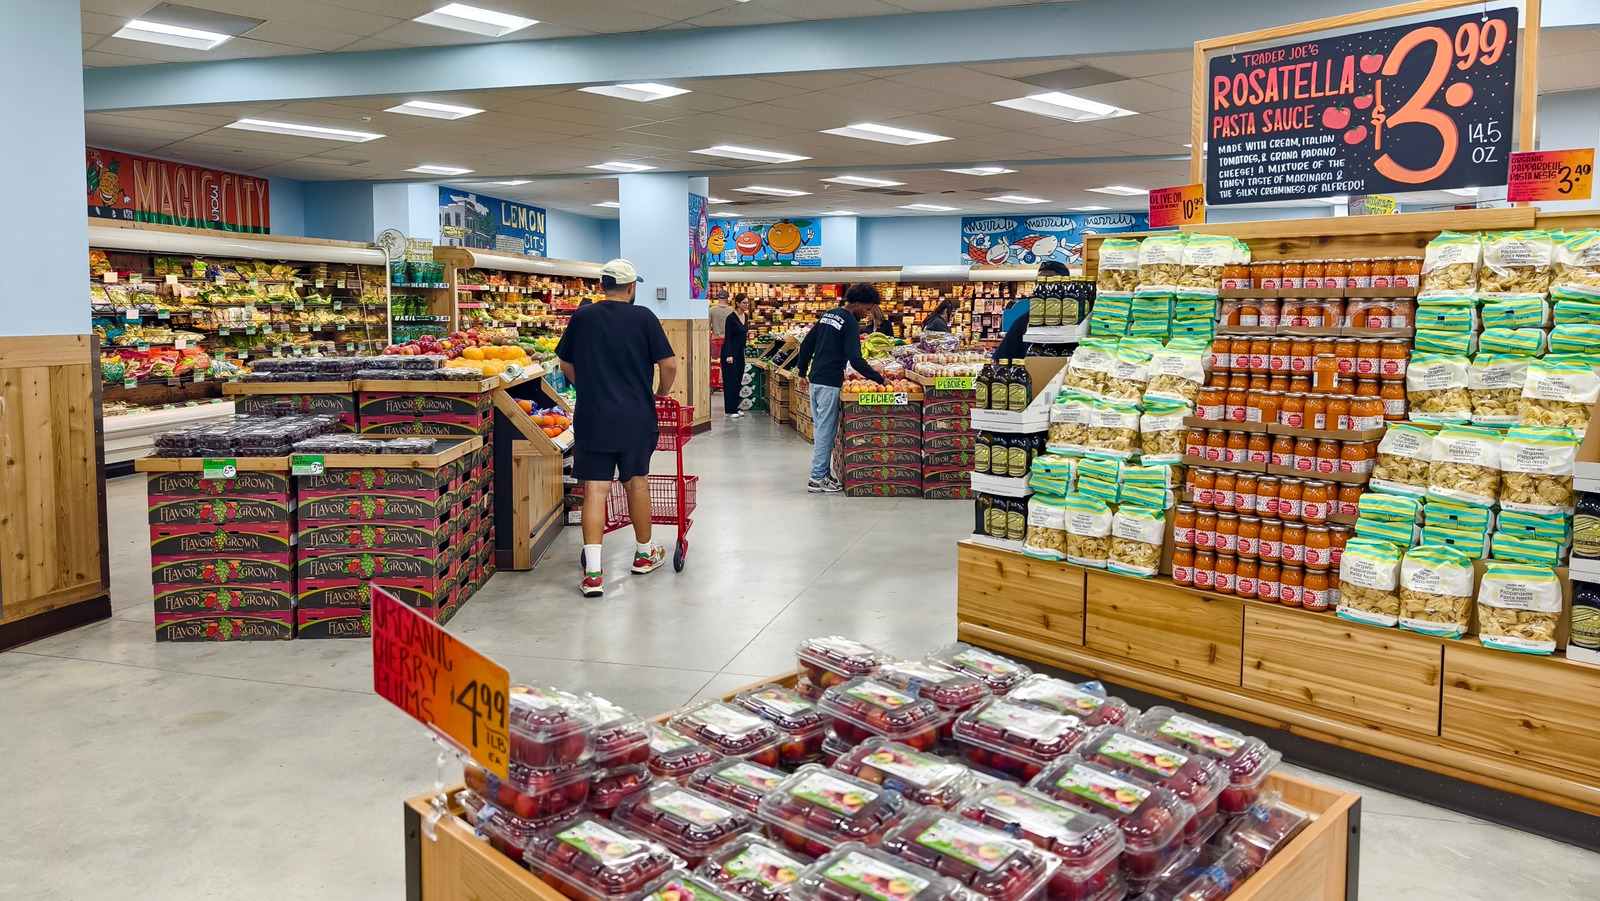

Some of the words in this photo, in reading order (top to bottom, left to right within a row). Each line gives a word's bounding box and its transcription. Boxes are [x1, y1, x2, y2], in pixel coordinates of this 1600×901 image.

[1242, 50, 1285, 68] TRADER
[1288, 44, 1319, 60] JOE'S
[1213, 55, 1355, 111] ROSATELLA
[1213, 112, 1256, 139] PASTA
[1262, 104, 1315, 133] SAUCE
[1468, 121, 1502, 144] 14.5
[1218, 142, 1242, 154] MADE
[1246, 140, 1266, 152] WITH
[1270, 138, 1301, 150] CREAM,
[1302, 134, 1335, 146] ITALIAN
[1219, 154, 1261, 167] TOMATOES,
[1261, 152, 1267, 162] &
[1270, 150, 1299, 162] GRANA
[1301, 147, 1336, 159] PADANO
[1472, 146, 1498, 163] OZ
[1511, 155, 1544, 164] ORGANIC
[1219, 166, 1254, 179] CHEESE!
[1258, 165, 1264, 174] A
[1268, 162, 1309, 174] MIXTURE
[1312, 160, 1324, 169] OF
[1328, 158, 1346, 168] THE
[1511, 161, 1564, 173] PAPPARDELLE
[1219, 178, 1245, 188] TANGY
[1247, 176, 1272, 186] TASTE
[1274, 174, 1284, 184] OF
[1286, 172, 1332, 184] MARINARA
[1336, 170, 1344, 180] &
[1510, 172, 1532, 181] PASTA
[1533, 170, 1557, 180] NESTS
[132, 158, 214, 230] MAGIC
[220, 172, 266, 234] CITY
[1219, 190, 1232, 199] THE
[1236, 187, 1258, 198] SILKY
[1260, 184, 1306, 196] CREAMINESS
[1308, 184, 1318, 193] OF
[1322, 180, 1364, 192] ALFREDO!
[210, 184, 220, 222] 305
[1150, 193, 1172, 204] OLIVE
[1173, 192, 1182, 203] OIL
[501, 202, 545, 234] LEMON
[1025, 216, 1076, 236] merrily
[524, 234, 545, 252] CITY
[938, 380, 967, 388] PEACHES
[312, 399, 344, 410] GROWN
[386, 400, 413, 412] FLAVOR
[424, 400, 454, 411] GROWN
[860, 394, 894, 404] PEACHES
[932, 406, 952, 414] FLAVOR
[384, 426, 412, 434] FLAVOR
[422, 426, 450, 434] GROWN
[932, 438, 952, 447] FLAVOR
[929, 455, 949, 464] FLAVOR
[159, 476, 194, 492] FLAVOR
[238, 477, 276, 490] GROWN
[310, 474, 344, 488] FLAVOR
[387, 474, 423, 486] GROWN
[931, 488, 951, 496] FLAVOR
[160, 506, 195, 522] FLAVOR
[238, 506, 276, 519] GROWN
[310, 502, 344, 517] FLAVOR
[387, 503, 424, 516] GROWN
[181, 537, 213, 551] FLAVOR
[225, 536, 260, 550] GROWN
[310, 532, 344, 546] FLAVOR
[386, 532, 422, 545] GROWN
[164, 567, 198, 582] FLAVOR
[241, 566, 278, 580] GROWN
[310, 560, 344, 576] FLAVOR
[386, 560, 422, 574] GROWN
[166, 596, 200, 610] FLAVOR
[243, 595, 280, 608] GROWN
[325, 590, 357, 604] FLAVOR
[168, 626, 201, 640] FLAVOR
[244, 625, 281, 637] GROWN
[328, 622, 360, 635] FLAVOR
[374, 593, 453, 672] ORGANIC
[373, 630, 438, 696] CHERRY
[376, 665, 434, 724] PLUMS
[488, 756, 502, 766] EA
